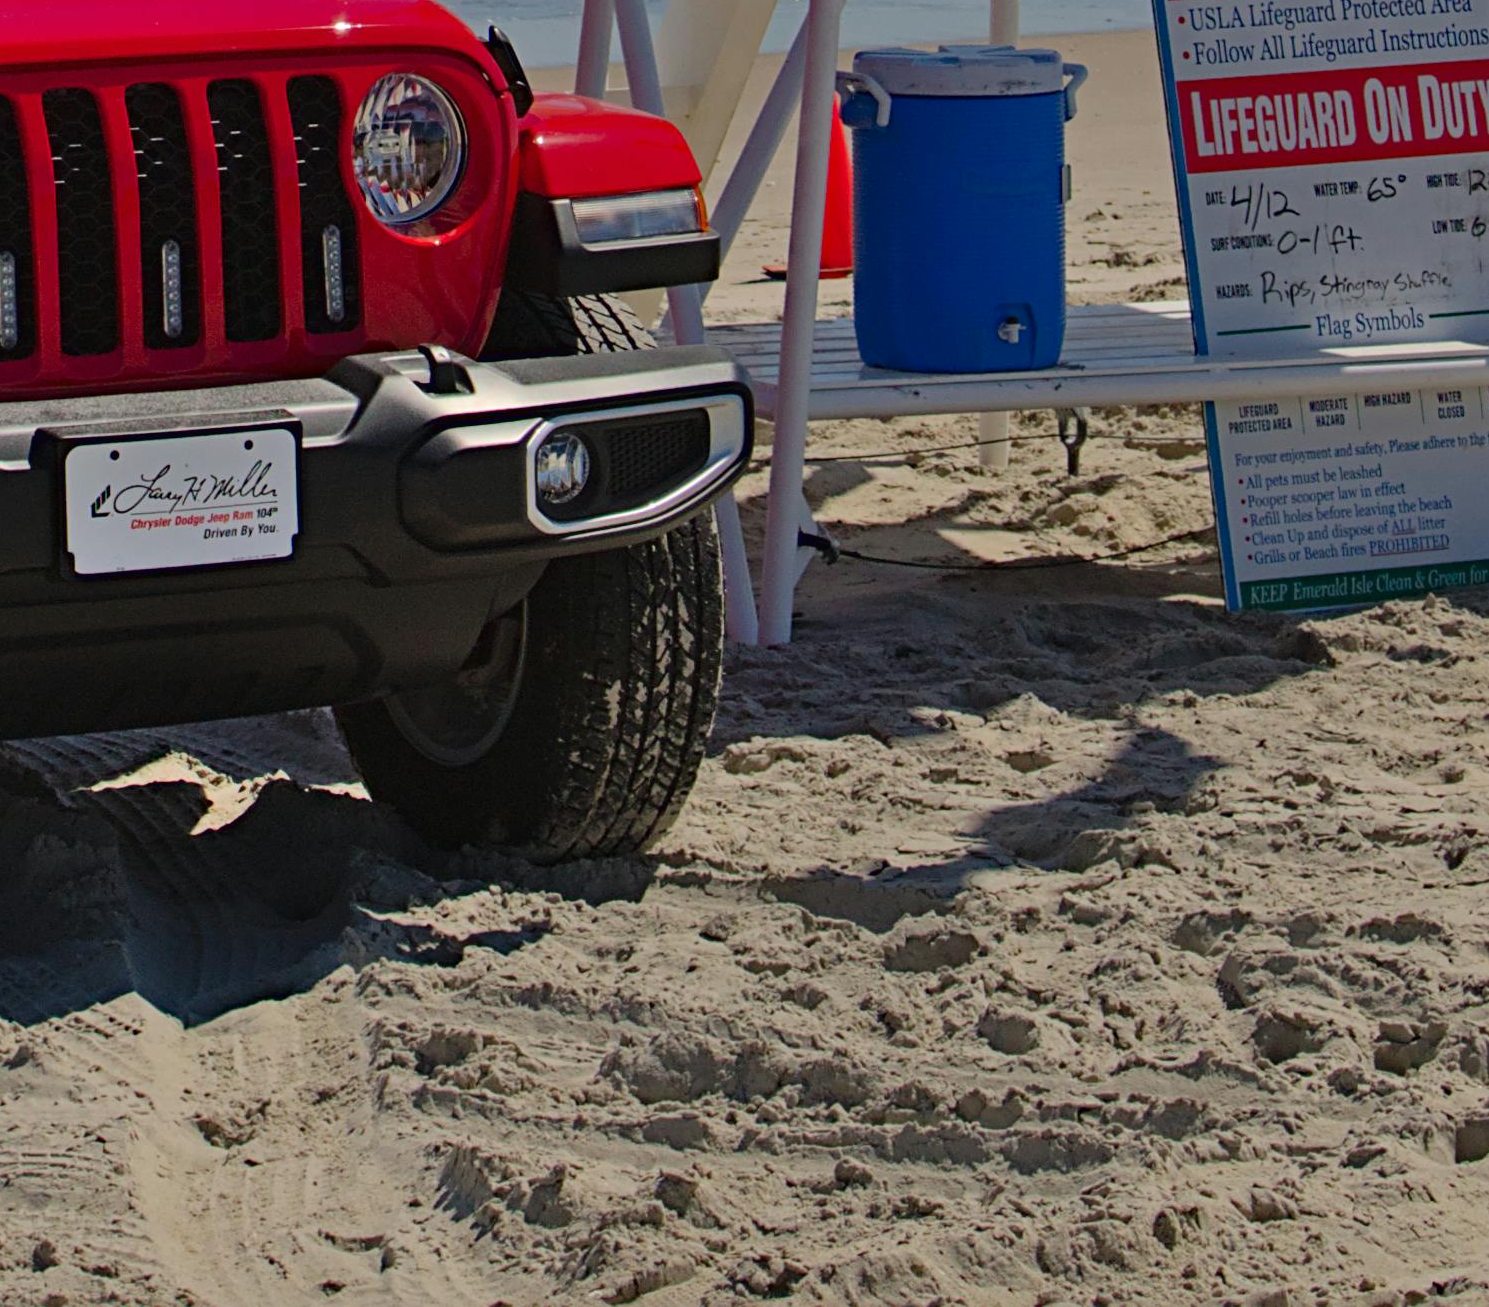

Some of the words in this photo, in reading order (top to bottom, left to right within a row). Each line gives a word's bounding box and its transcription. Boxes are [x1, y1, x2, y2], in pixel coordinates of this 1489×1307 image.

[1189, 5, 1244, 31] USLA
[1193, 39, 1255, 65] Follow
[1260, 36, 1285, 61] All
[1290, 27, 1377, 62] Lifeguard
[1380, 22, 1489, 53] Instructions
[1190, 89, 1357, 157] LIFEGUARD
[1314, 182, 1338, 197] WATER
[1205, 190, 1226, 206] DATE:
[1230, 183, 1300, 231] 4/12
[1432, 220, 1448, 234] LOW
[1211, 237, 1230, 251] SURF
[1320, 275, 1389, 303] Stingray
[1316, 315, 1353, 338] Flag
[1356, 307, 1424, 336] Symbols
[1309, 397, 1348, 413] MODERATE
[1364, 393, 1380, 407] HIGH
[1382, 392, 1411, 405] HAZARD
[1437, 390, 1462, 404] WATER
[1239, 403, 1279, 419] LIFEGUARD
[1315, 414, 1346, 427] HAZARD
[1437, 405, 1465, 419] CLOSED
[1228, 419, 1271, 435] PROTECTED
[1273, 417, 1292, 430] AREA
[1235, 453, 1253, 466] For
[1255, 453, 1278, 468] your
[1280, 448, 1332, 465] enjoyment
[1334, 443, 1353, 458] and
[1388, 439, 1420, 453] Please
[1423, 436, 1455, 450] adhere
[1457, 435, 1468, 446] to
[1470, 432, 1486, 447] the
[1246, 473, 1262, 489] All
[1265, 474, 1289, 491] pets
[1292, 471, 1320, 485] must
[1323, 468, 1337, 482] be
[1339, 463, 1382, 481] leashed
[1248, 494, 1288, 509] Pooper
[1291, 489, 1335, 505] scooper
[1337, 486, 1357, 500] law
[1360, 485, 1372, 498] in
[1375, 481, 1407, 497] effect
[131, 516, 172, 530] Chrysler
[175, 514, 205, 526] Dodge
[208, 512, 230, 525] Jeep
[233, 510, 253, 522] Ram
[1250, 510, 1280, 527] Refill
[1283, 508, 1313, 524] holes
[1315, 505, 1353, 521] before
[1355, 502, 1396, 517] leaving
[1398, 499, 1417, 514] the
[1419, 495, 1453, 512] beach
[204, 527, 237, 540] Driven
[241, 525, 253, 537] By
[1252, 531, 1284, 546] Clean
[1287, 528, 1305, 545] Up
[1307, 525, 1329, 541] and
[1332, 522, 1374, 540] dispose
[1377, 519, 1390, 533] of
[1392, 519, 1416, 533] ALL
[1418, 517, 1446, 532] litter
[1254, 548, 1286, 565] Grills
[1289, 551, 1301, 562] or
[1303, 544, 1339, 560] Beach
[1342, 542, 1367, 556] fires
[1369, 535, 1450, 553] PROHIBITED
[1250, 583, 1288, 605] KEEP
[1293, 576, 1348, 601] Emerald
[1350, 574, 1373, 595] Isle
[1377, 572, 1412, 592] Clean
[1414, 574, 1425, 589] &
[1428, 568, 1466, 586] Green
[1470, 565, 1488, 583] for
